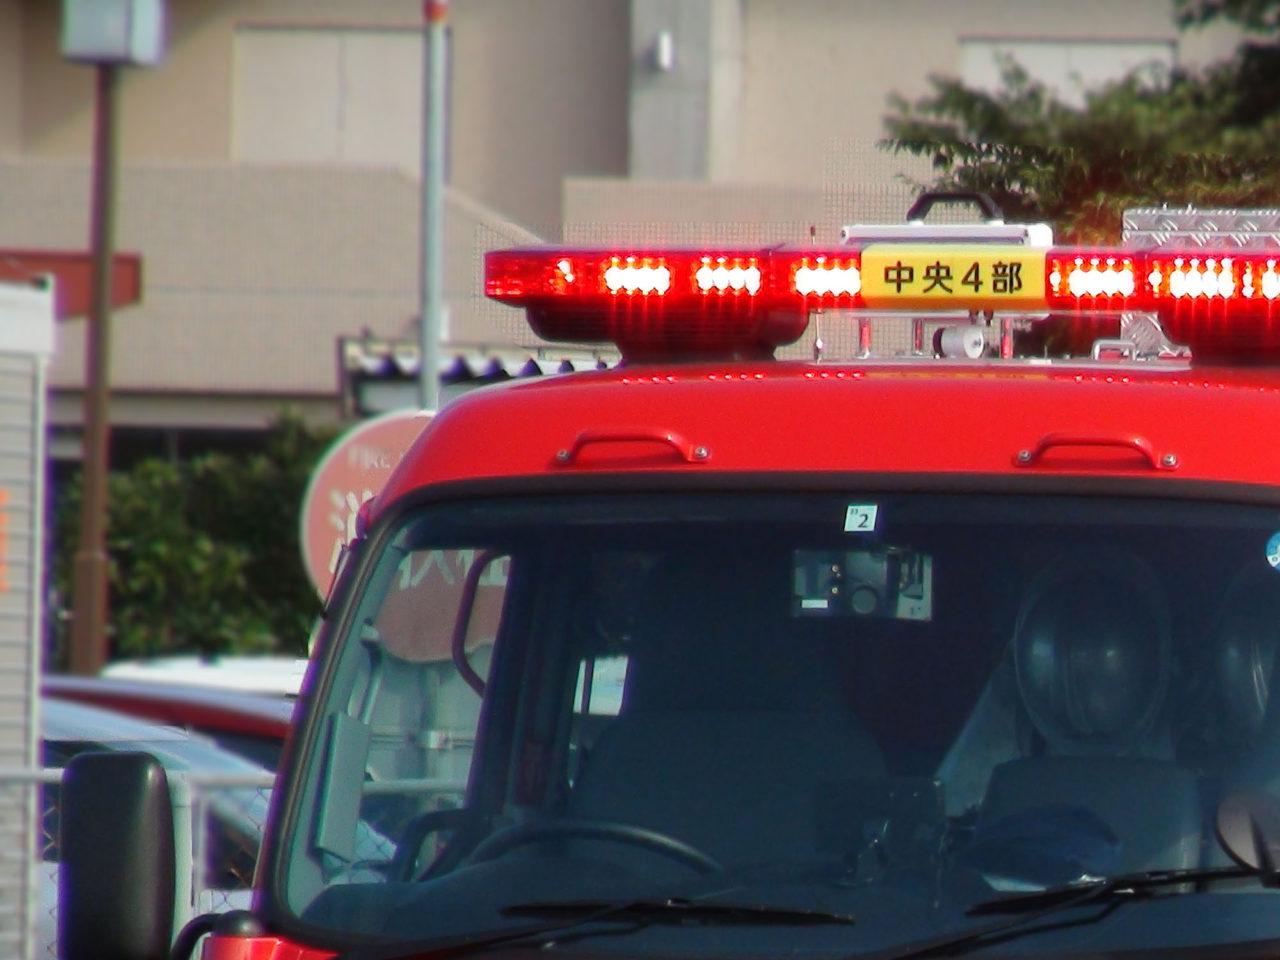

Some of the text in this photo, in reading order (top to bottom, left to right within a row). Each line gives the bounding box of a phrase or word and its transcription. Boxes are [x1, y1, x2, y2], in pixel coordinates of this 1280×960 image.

[884, 260, 1023, 294] 中央4部
[857, 513, 869, 528] 2
